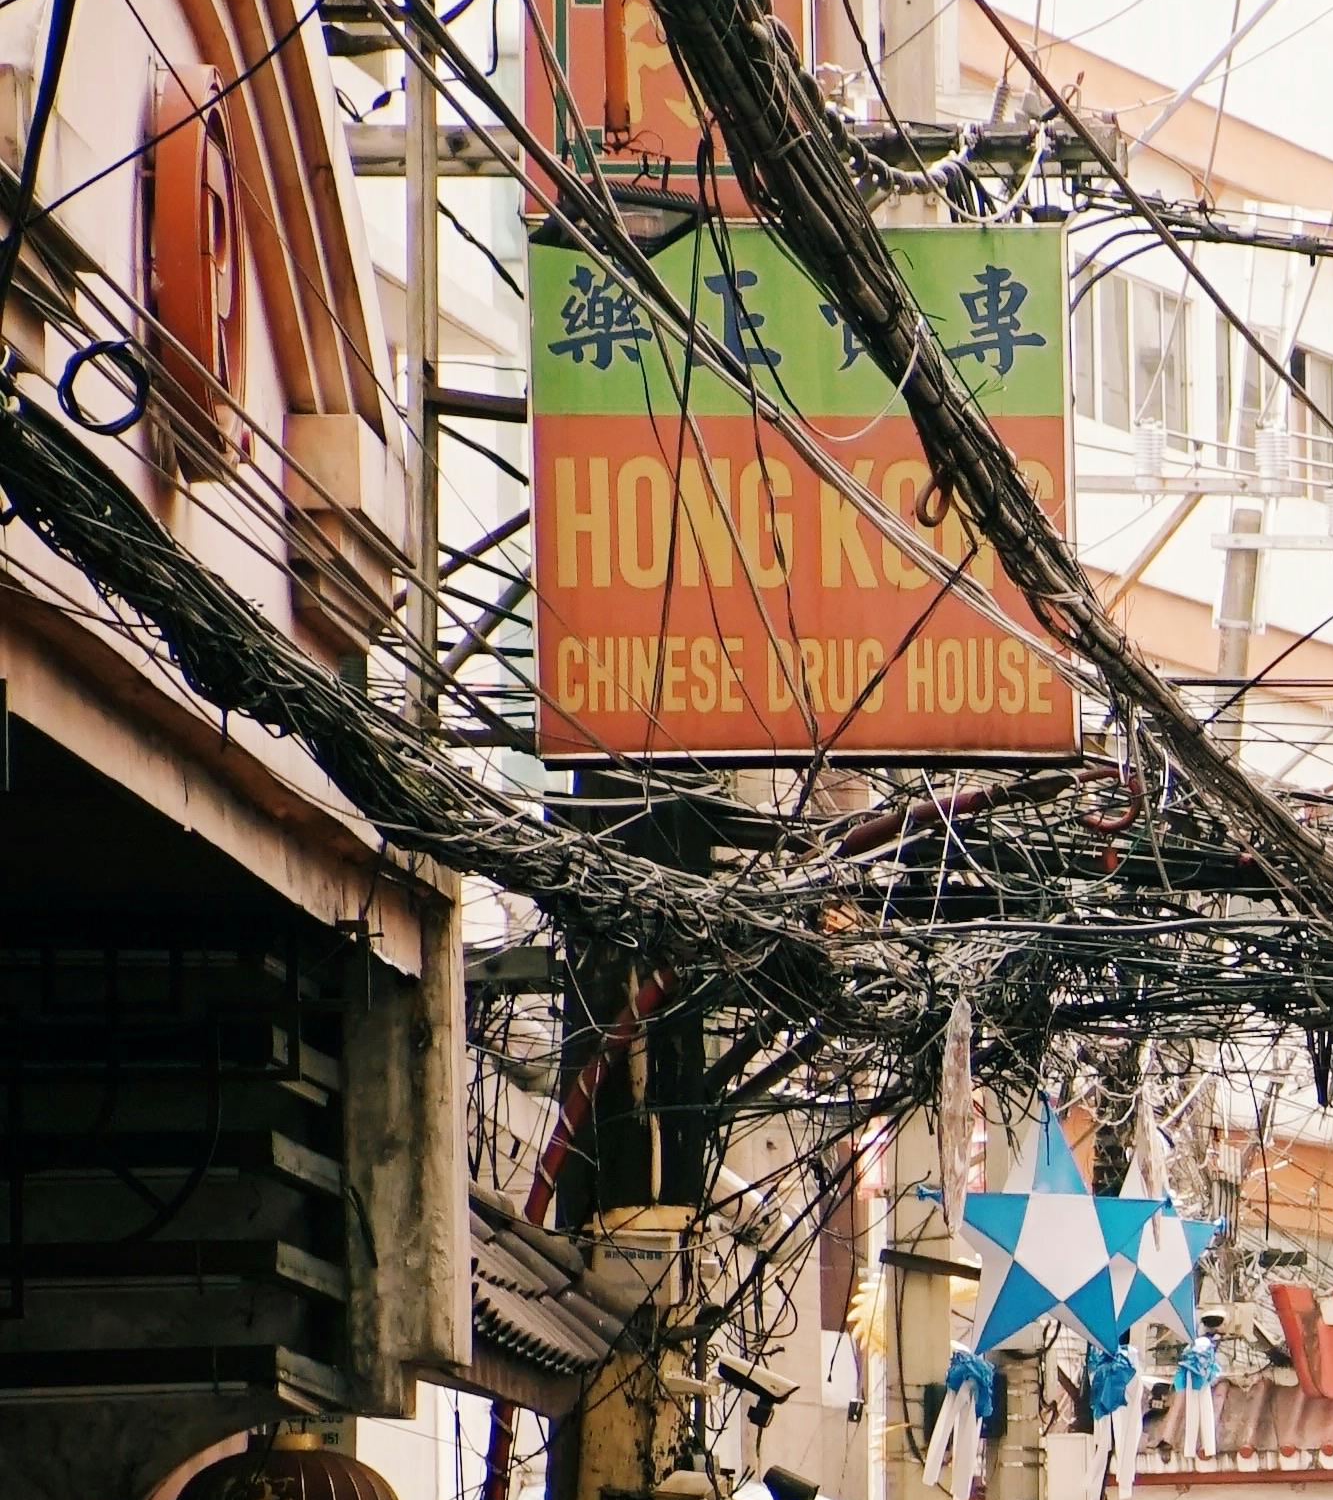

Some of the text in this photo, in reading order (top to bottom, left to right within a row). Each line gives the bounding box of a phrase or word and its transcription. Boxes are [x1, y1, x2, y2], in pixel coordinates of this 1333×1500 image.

[553, 455, 795, 590] HONG
[556, 635, 1054, 714] CHINESE DRUG HOUSE
